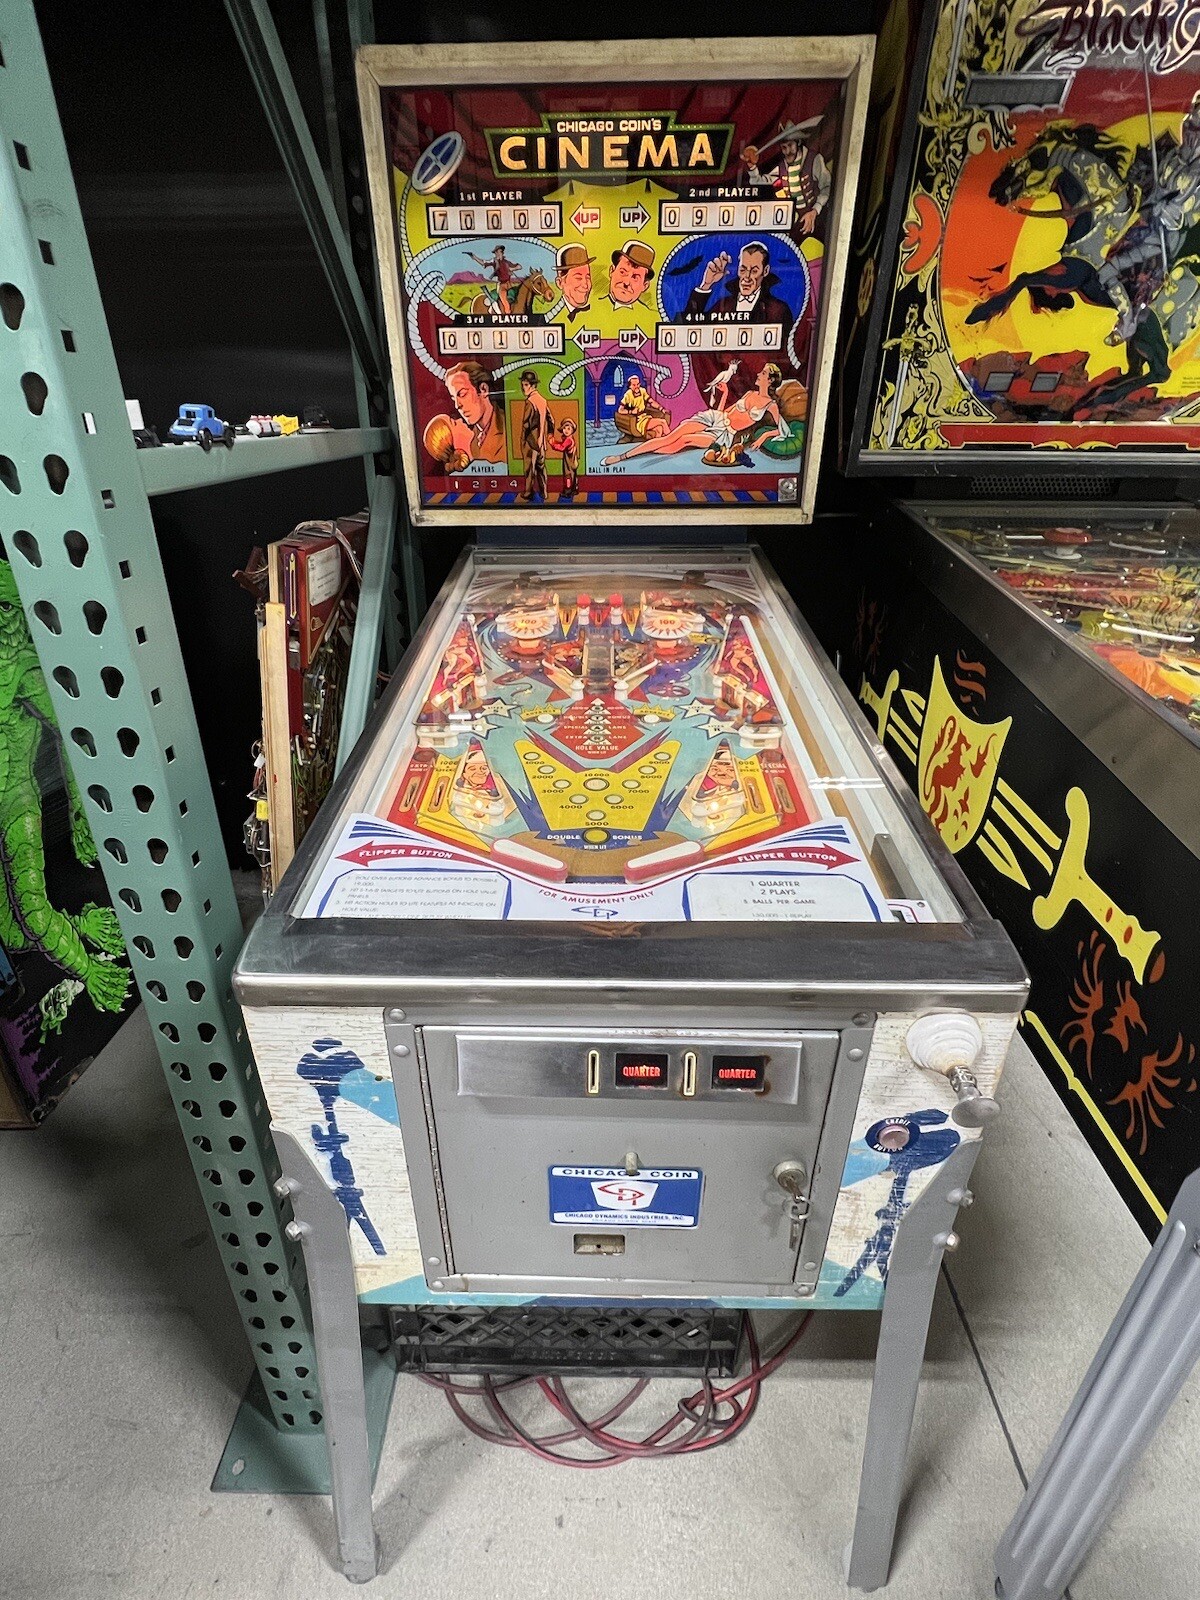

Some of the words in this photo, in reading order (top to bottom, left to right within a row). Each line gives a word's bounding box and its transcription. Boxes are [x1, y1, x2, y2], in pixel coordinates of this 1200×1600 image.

[556, 121, 614, 133] CHICAGO
[619, 117, 662, 132] COIN'S
[500, 132, 715, 170] CINEMA
[460, 192, 476, 201] 1st
[482, 191, 523, 200] PLAYER
[689, 188, 711, 197] 2nd
[718, 187, 759, 197] PLAYER
[580, 213, 599, 223] UP
[622, 212, 640, 223] UP
[466, 316, 485, 324] 3rd
[492, 315, 529, 323] PLAYER
[686, 312, 705, 321] 4th
[711, 312, 750, 321] PLAYER
[583, 334, 600, 344] UP
[621, 333, 638, 343] UP
[472, 480, 480, 489] 2
[490, 480, 498, 488] 3
[509, 480, 518, 488] 4
[358, 849, 406, 857] FLIPPER
[410, 849, 453, 859] BUTTON
[737, 852, 785, 862] FLIPPER
[791, 852, 837, 862] BUTTON
[538, 889, 557, 899] FOR
[561, 895, 625, 904] AMUSEMENT
[629, 890, 655, 902] ONLY
[622, 1065, 661, 1077] QUARTER
[718, 1068, 757, 1079] QUARTER
[885, 1117, 911, 1126] CREDIT
[650, 1170, 692, 1178] COIN
